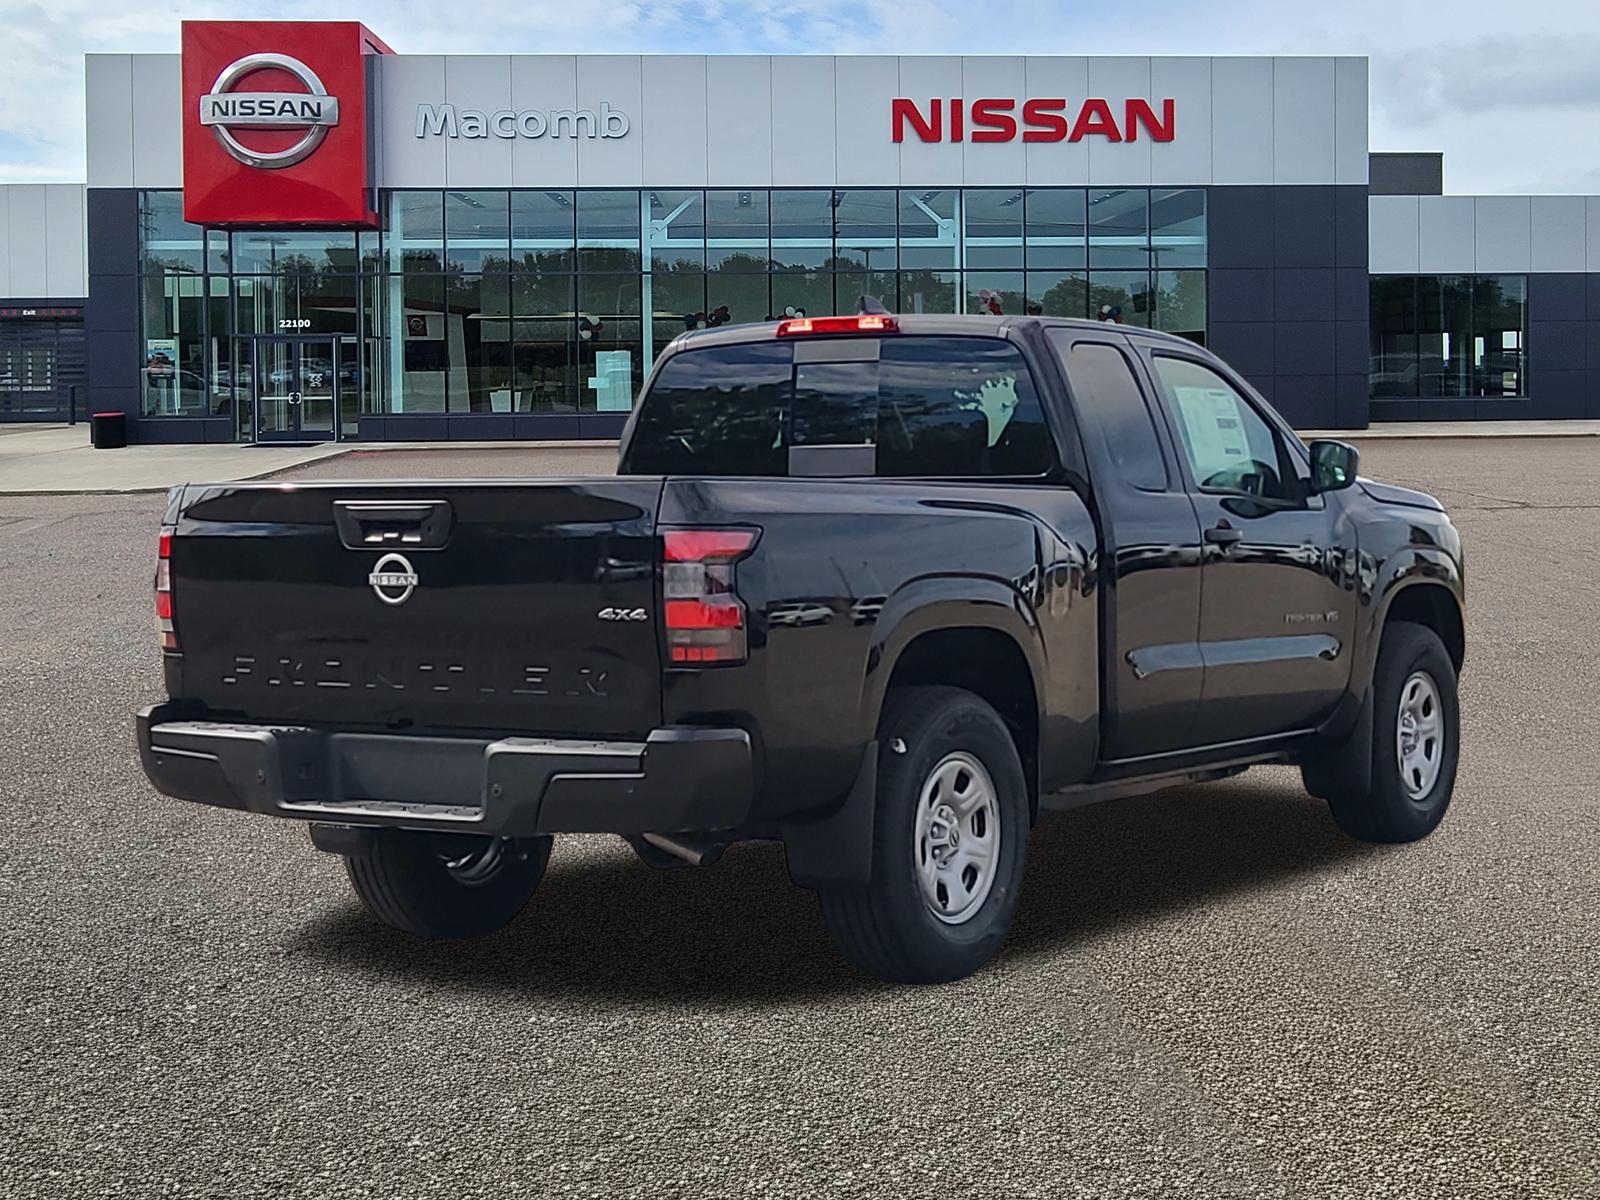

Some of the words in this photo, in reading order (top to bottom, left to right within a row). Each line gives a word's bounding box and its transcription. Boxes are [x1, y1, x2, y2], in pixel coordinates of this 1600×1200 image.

[212, 100, 322, 118] NISSAN
[415, 102, 631, 139] Macomb
[891, 98, 1176, 143] NISSAN
[279, 319, 311, 328] 22100
[368, 574, 418, 586] NISSAN
